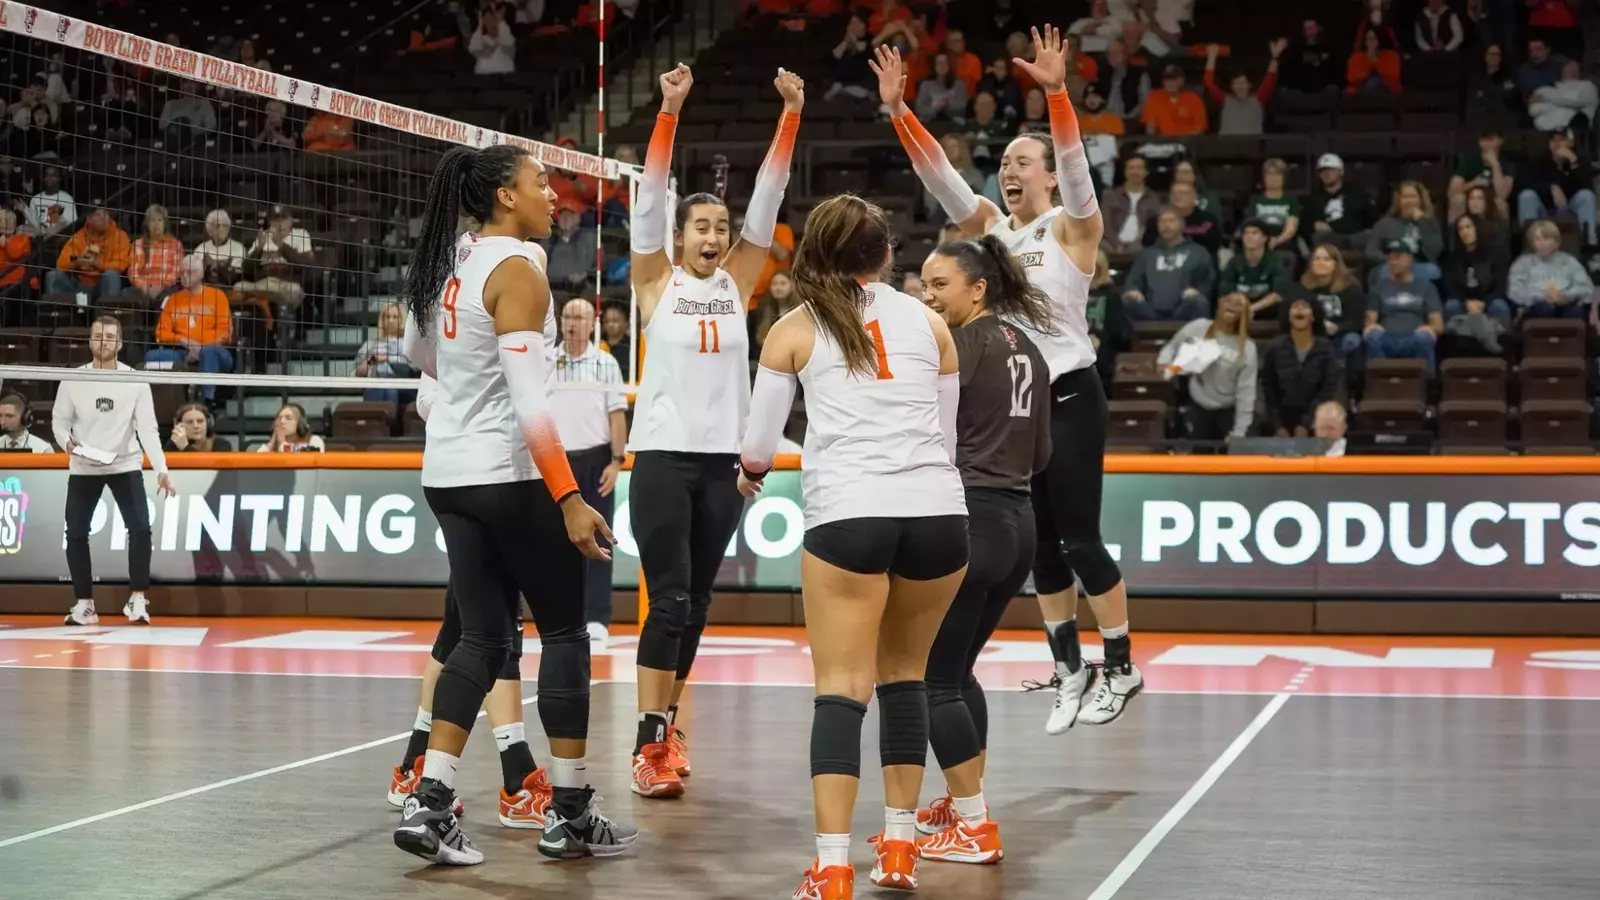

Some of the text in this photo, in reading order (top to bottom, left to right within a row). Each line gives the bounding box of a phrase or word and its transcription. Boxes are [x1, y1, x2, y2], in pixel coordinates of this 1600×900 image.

[83, 24, 278, 96] BOWLING GREEN VOLLEYBALL
[329, 91, 468, 144] BOWLING GREEN VOLLEYBALL
[443, 277, 461, 340] 9
[673, 297, 737, 315] BOWLING GREEN
[698, 319, 720, 354] 11
[863, 318, 895, 380] 1
[1006, 354, 1033, 418] 12
[1140, 499, 1600, 568] PRODUCTS
